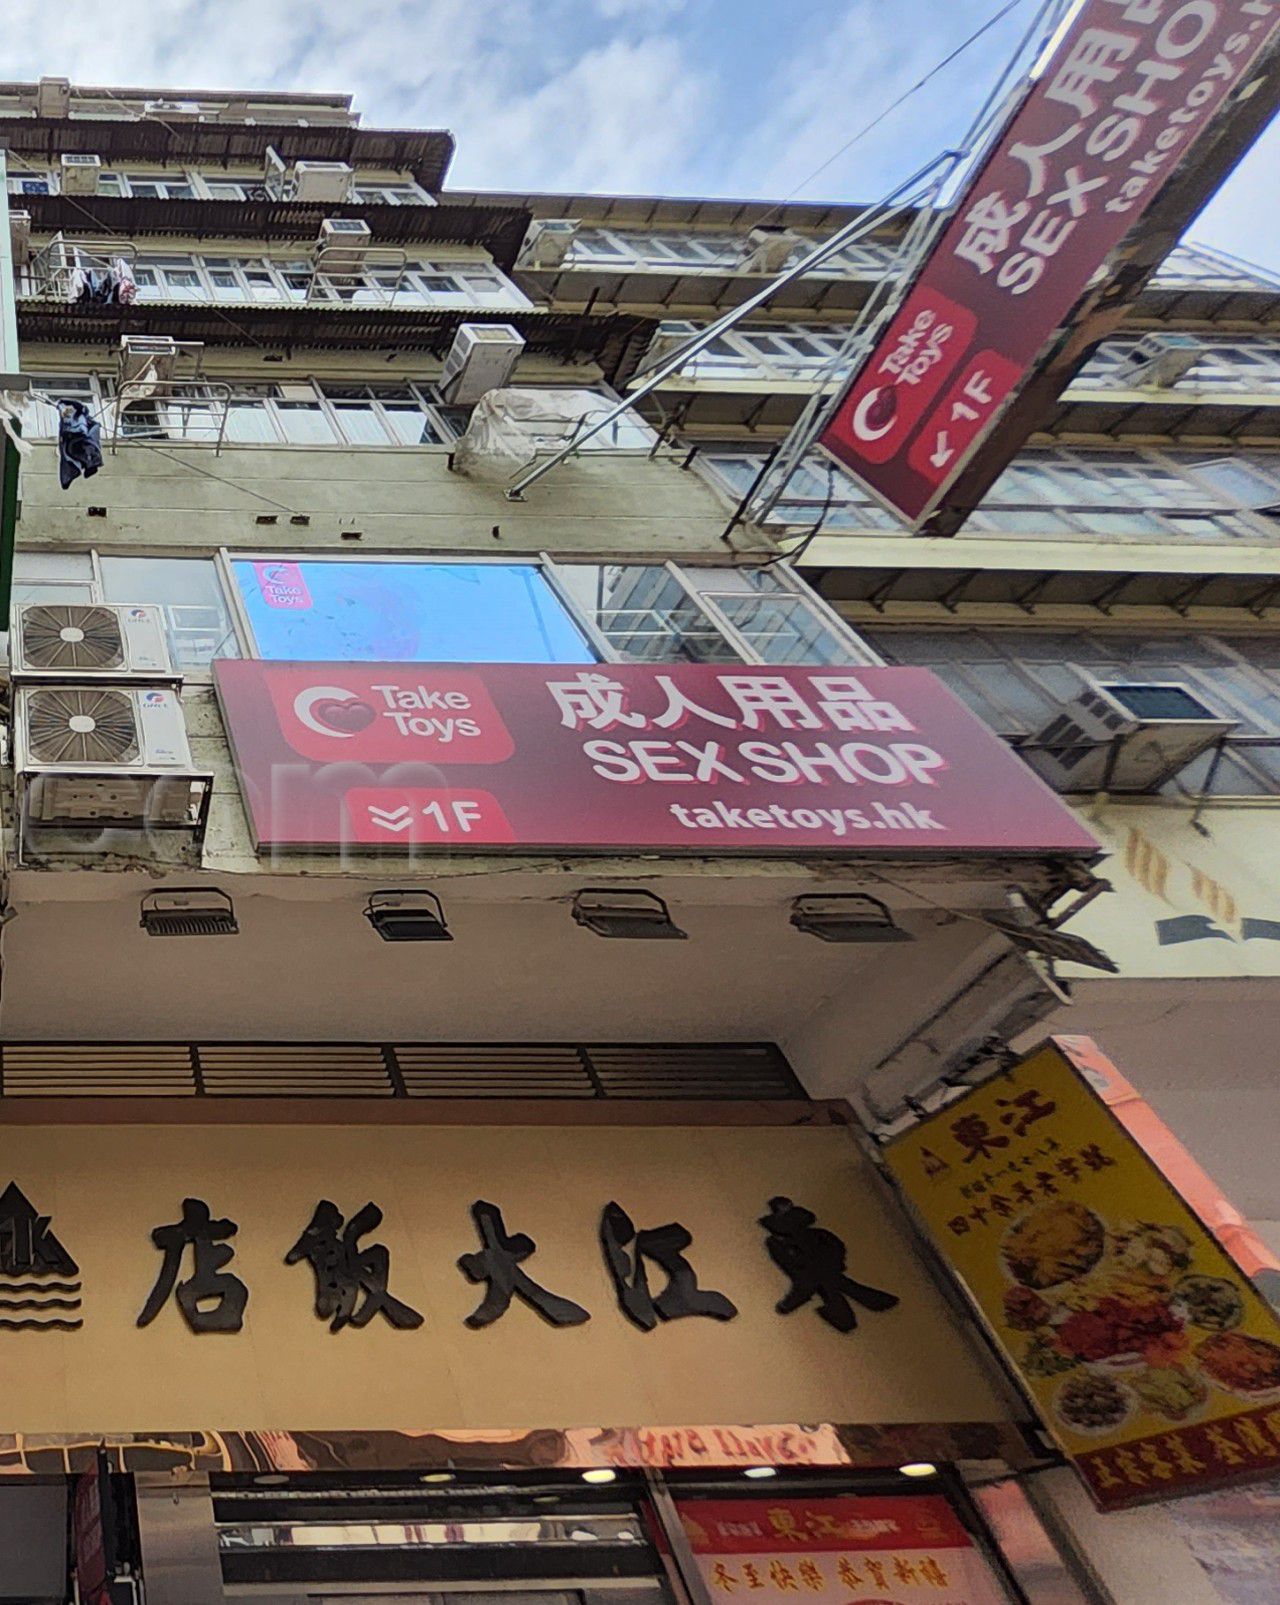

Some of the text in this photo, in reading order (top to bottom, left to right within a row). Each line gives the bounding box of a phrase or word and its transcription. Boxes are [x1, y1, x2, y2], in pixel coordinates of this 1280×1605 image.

[997, 166, 1108, 295] SEX
[878, 309, 936, 375] Take
[895, 322, 953, 385] Toys
[951, 369, 993, 422] 1F
[371, 685, 471, 710] Take
[545, 672, 916, 732] 成人用品
[383, 711, 481, 742] Toys
[582, 739, 947, 786] SEX SHOP
[422, 800, 482, 832] 1F
[670, 800, 947, 836] taketoys.hk
[949, 1088, 1056, 1165] 東江
